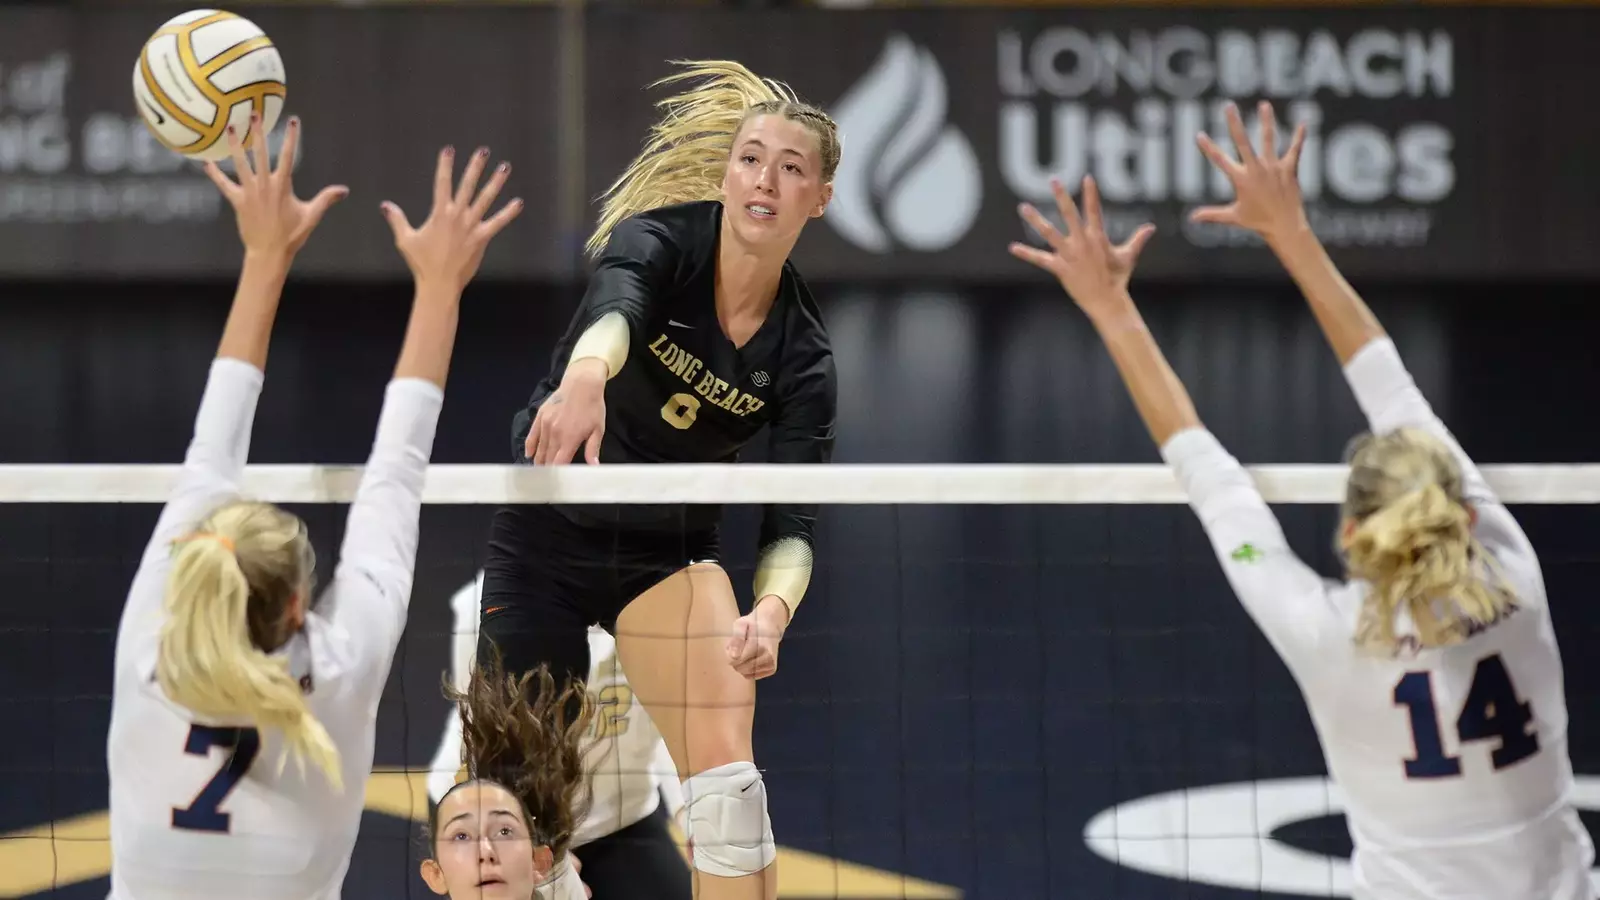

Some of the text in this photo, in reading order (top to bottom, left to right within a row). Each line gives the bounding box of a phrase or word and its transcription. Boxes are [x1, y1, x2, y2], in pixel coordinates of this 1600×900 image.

[648, 333, 702, 384] LONG
[583, 684, 633, 738] 2
[1391, 653, 1542, 780] 14
[170, 723, 261, 835] 7
